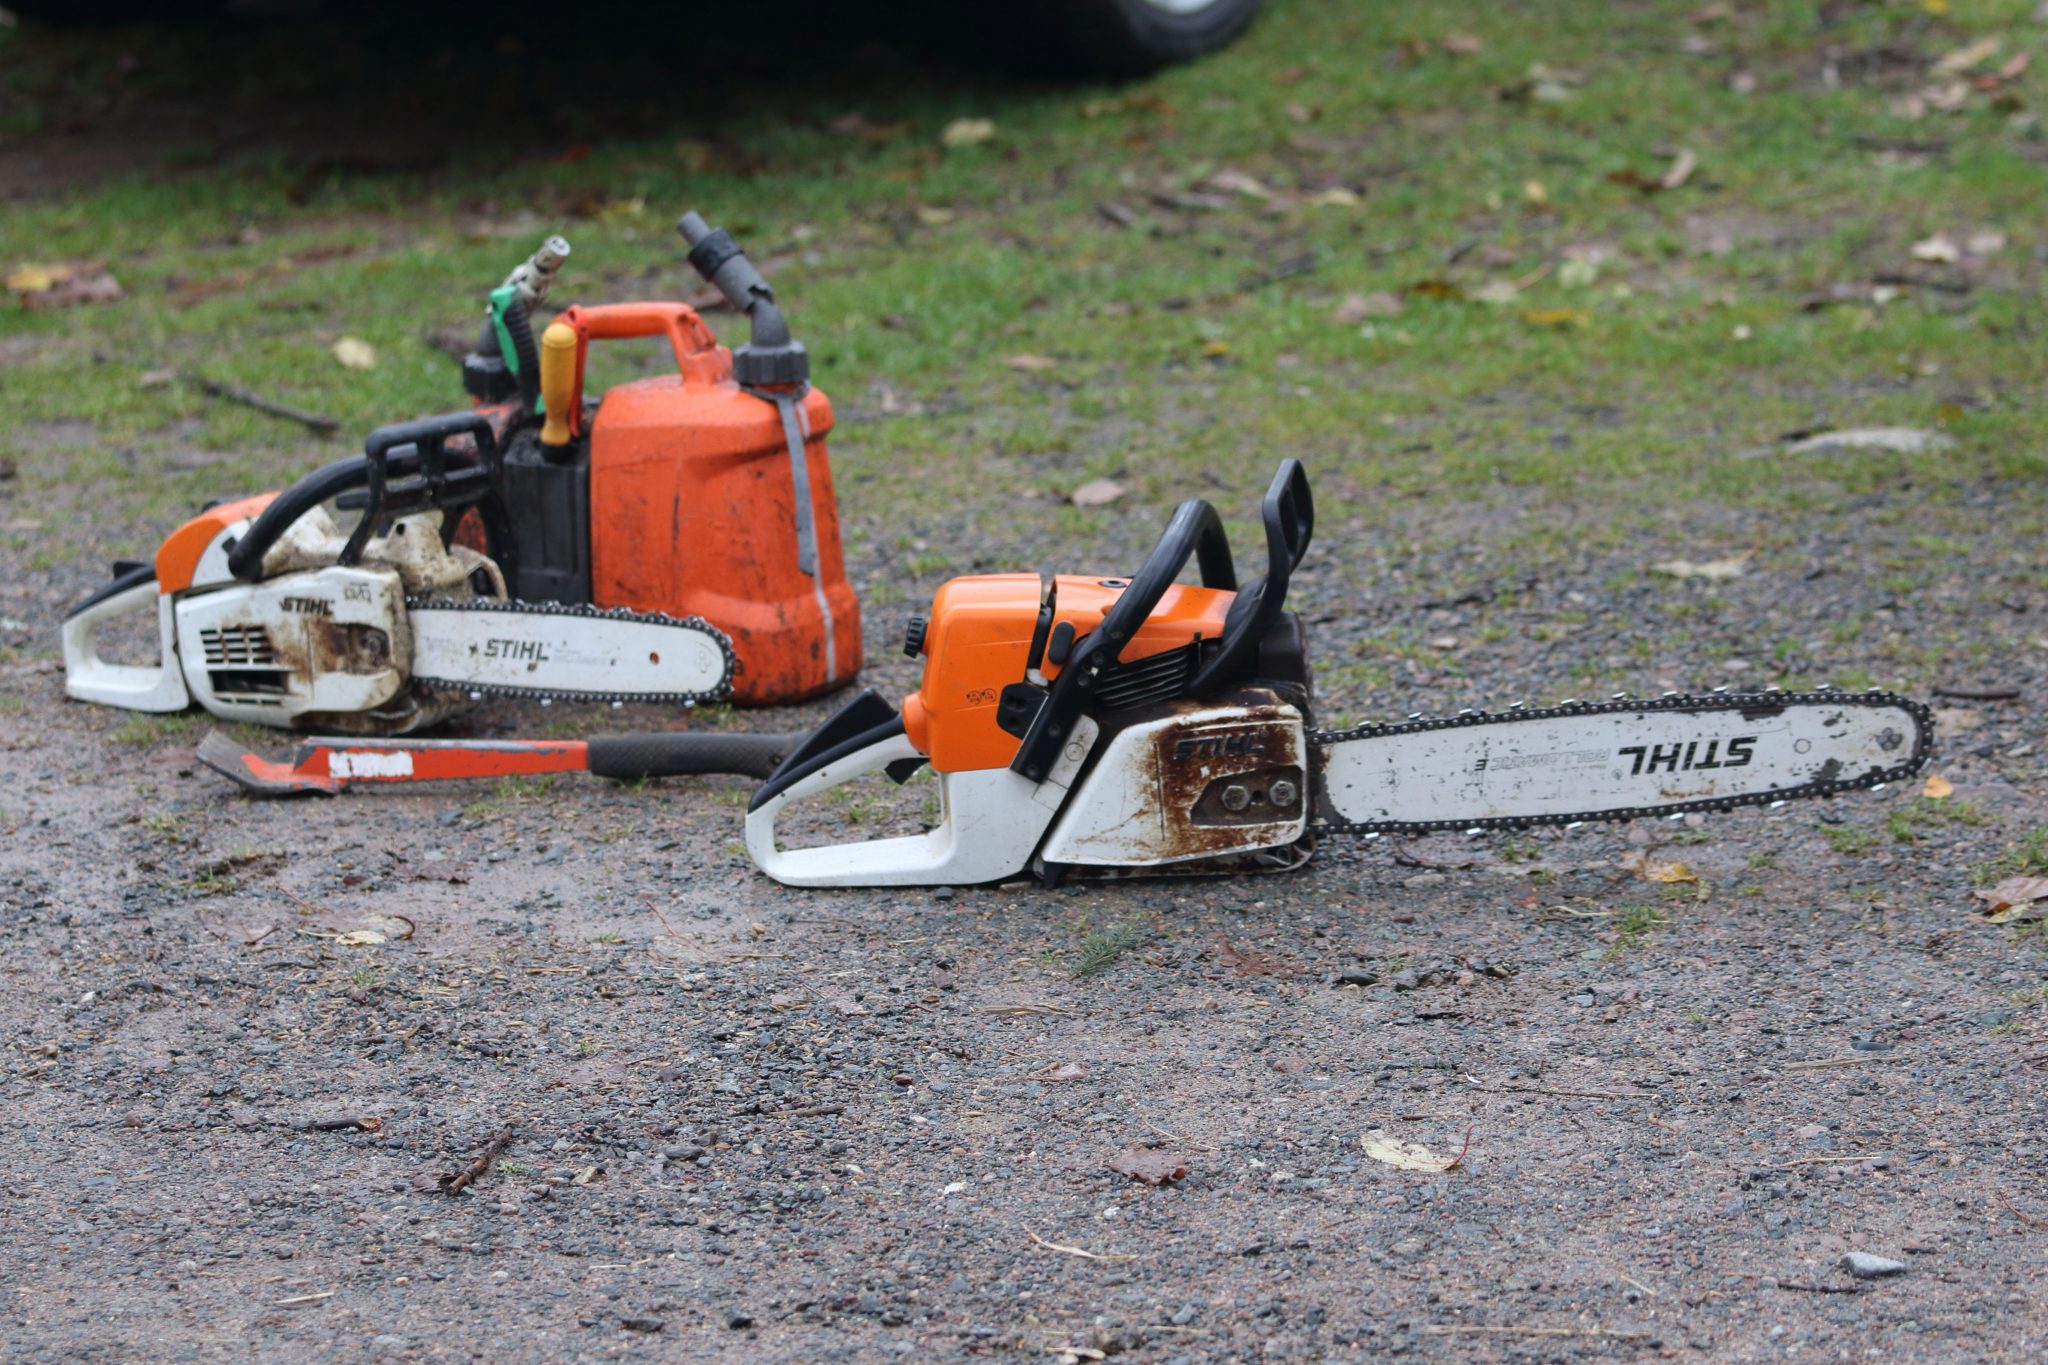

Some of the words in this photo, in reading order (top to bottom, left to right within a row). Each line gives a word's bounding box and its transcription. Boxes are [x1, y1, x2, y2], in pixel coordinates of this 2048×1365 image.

[279, 596, 334, 617] STIHL
[484, 637, 549, 661] STIHL
[1174, 733, 1265, 760] STIHL
[1618, 736, 1758, 776] STIHL
